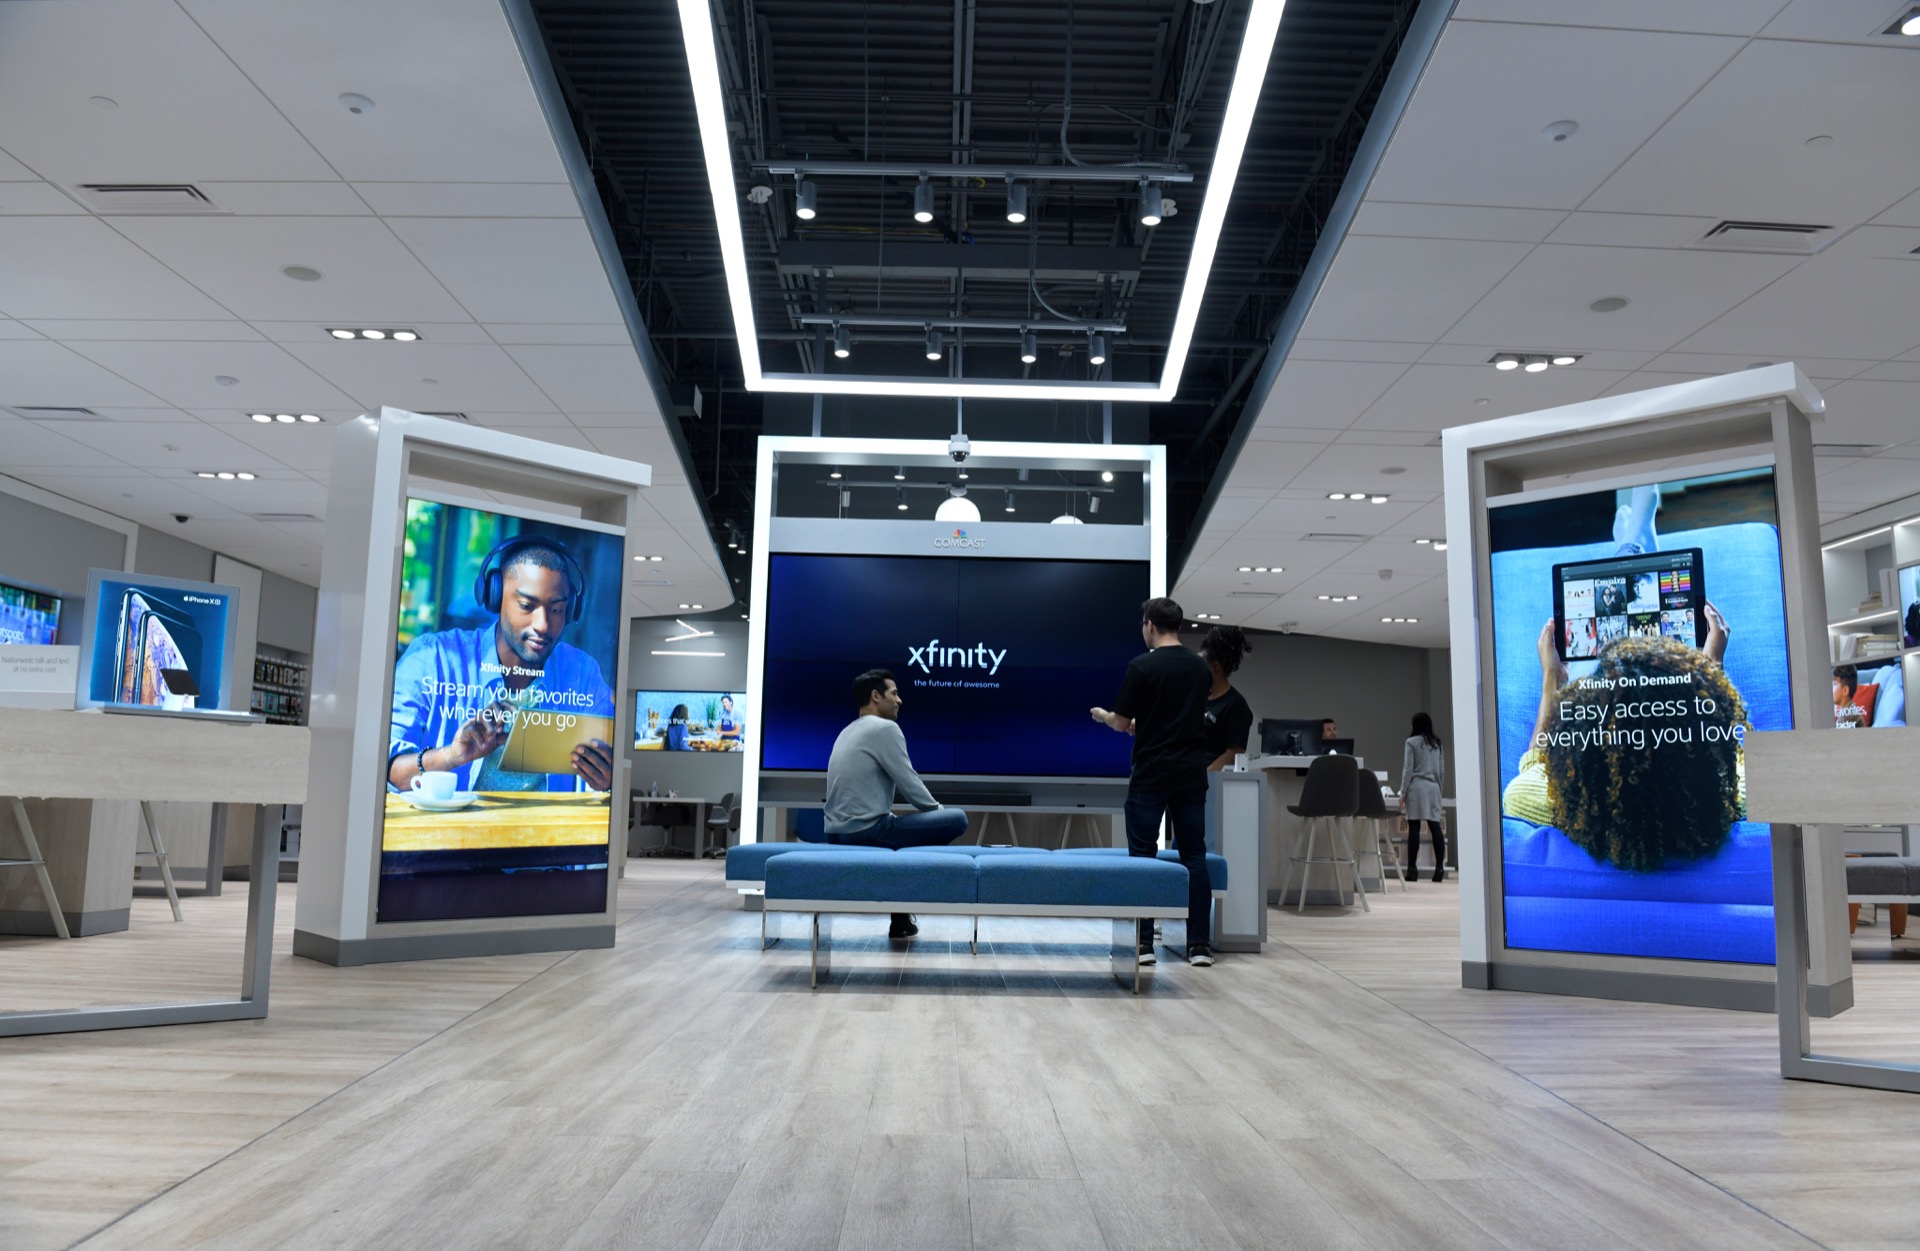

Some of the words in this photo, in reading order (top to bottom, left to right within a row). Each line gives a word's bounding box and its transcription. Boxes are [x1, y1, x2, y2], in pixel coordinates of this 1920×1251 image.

[934, 538, 986, 549] COMCAST
[189, 595, 210, 604] iPhone
[0, 627, 24, 640] tspots
[2, 656, 33, 664] Nationwide
[46, 657, 57, 665] and
[907, 639, 1007, 676] xfinity
[480, 662, 511, 677] Xfinity
[512, 665, 545, 678] Stream
[914, 679, 927, 687] the
[928, 679, 952, 687] future
[953, 680, 962, 688] of
[963, 681, 1000, 689] awesome
[1578, 678, 1616, 691] Xfinity
[1618, 676, 1637, 688] On
[1639, 672, 1692, 687] Demand
[421, 676, 484, 698] Stream
[488, 686, 524, 702] your
[530, 685, 594, 707] favorites
[439, 702, 519, 724] wherever
[521, 710, 551, 730] you
[556, 713, 577, 732] go
[1559, 700, 1609, 724] Easy
[1614, 698, 1688, 718] access
[1693, 696, 1716, 715] to
[1535, 725, 1645, 752] everything
[1651, 727, 1692, 749] you
[1700, 721, 1747, 742] love
